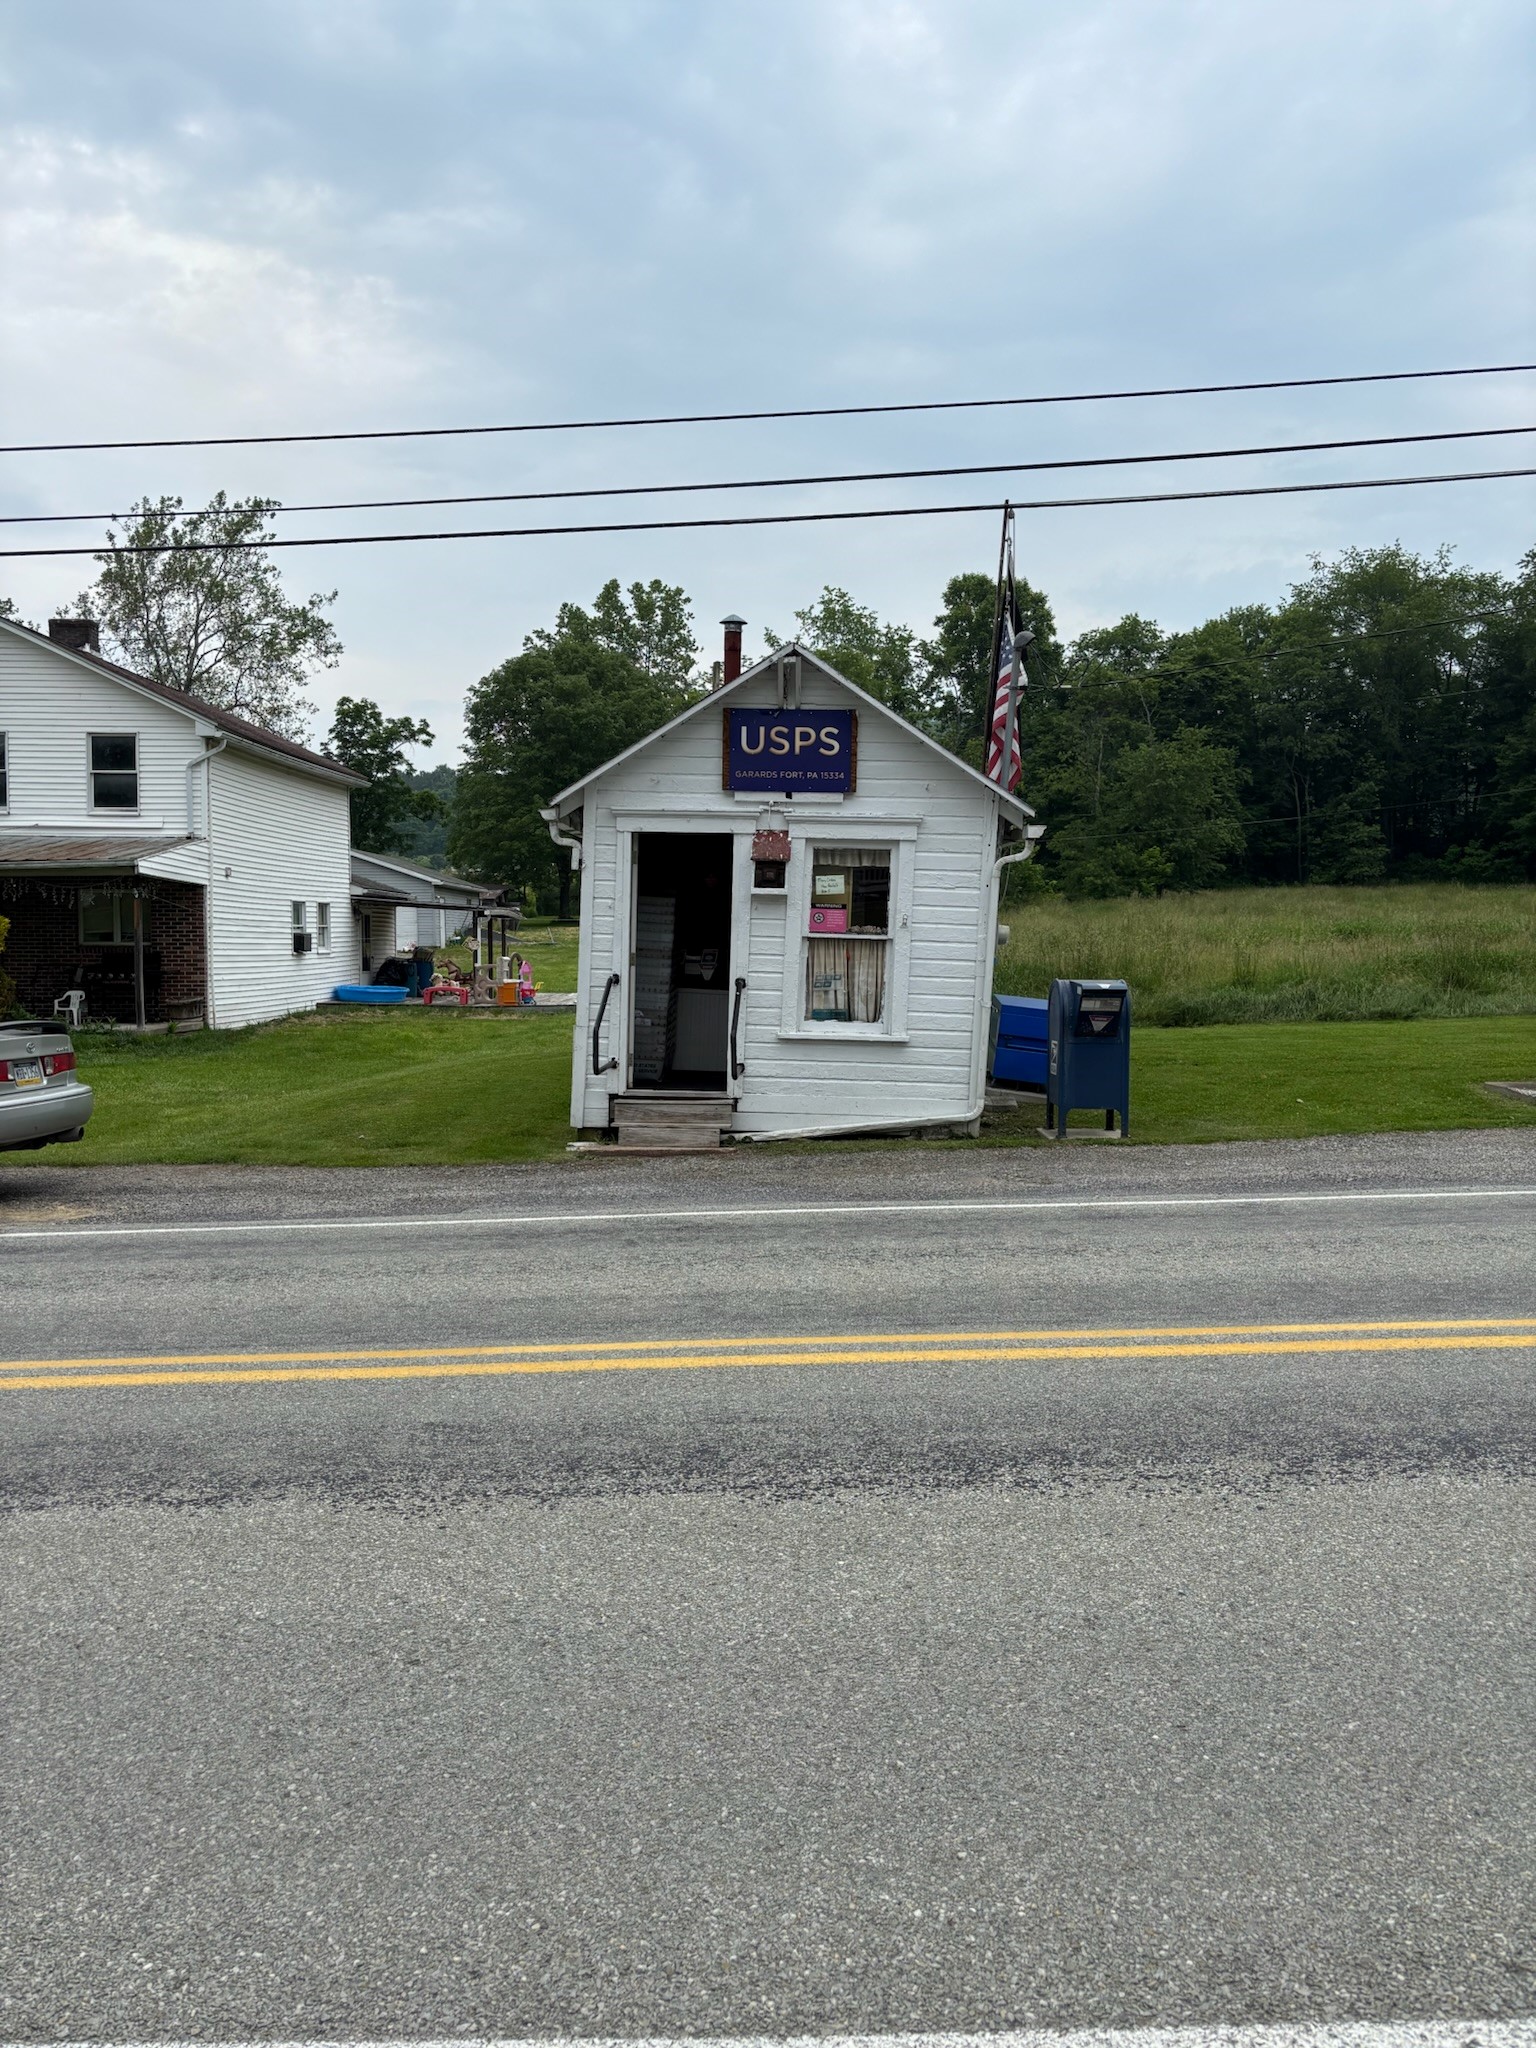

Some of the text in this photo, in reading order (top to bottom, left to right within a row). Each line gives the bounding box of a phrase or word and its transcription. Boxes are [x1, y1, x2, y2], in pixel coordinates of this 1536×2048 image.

[740, 726, 840, 756] USPS
[735, 770, 845, 780] GARARDS FORT, PA 15334
